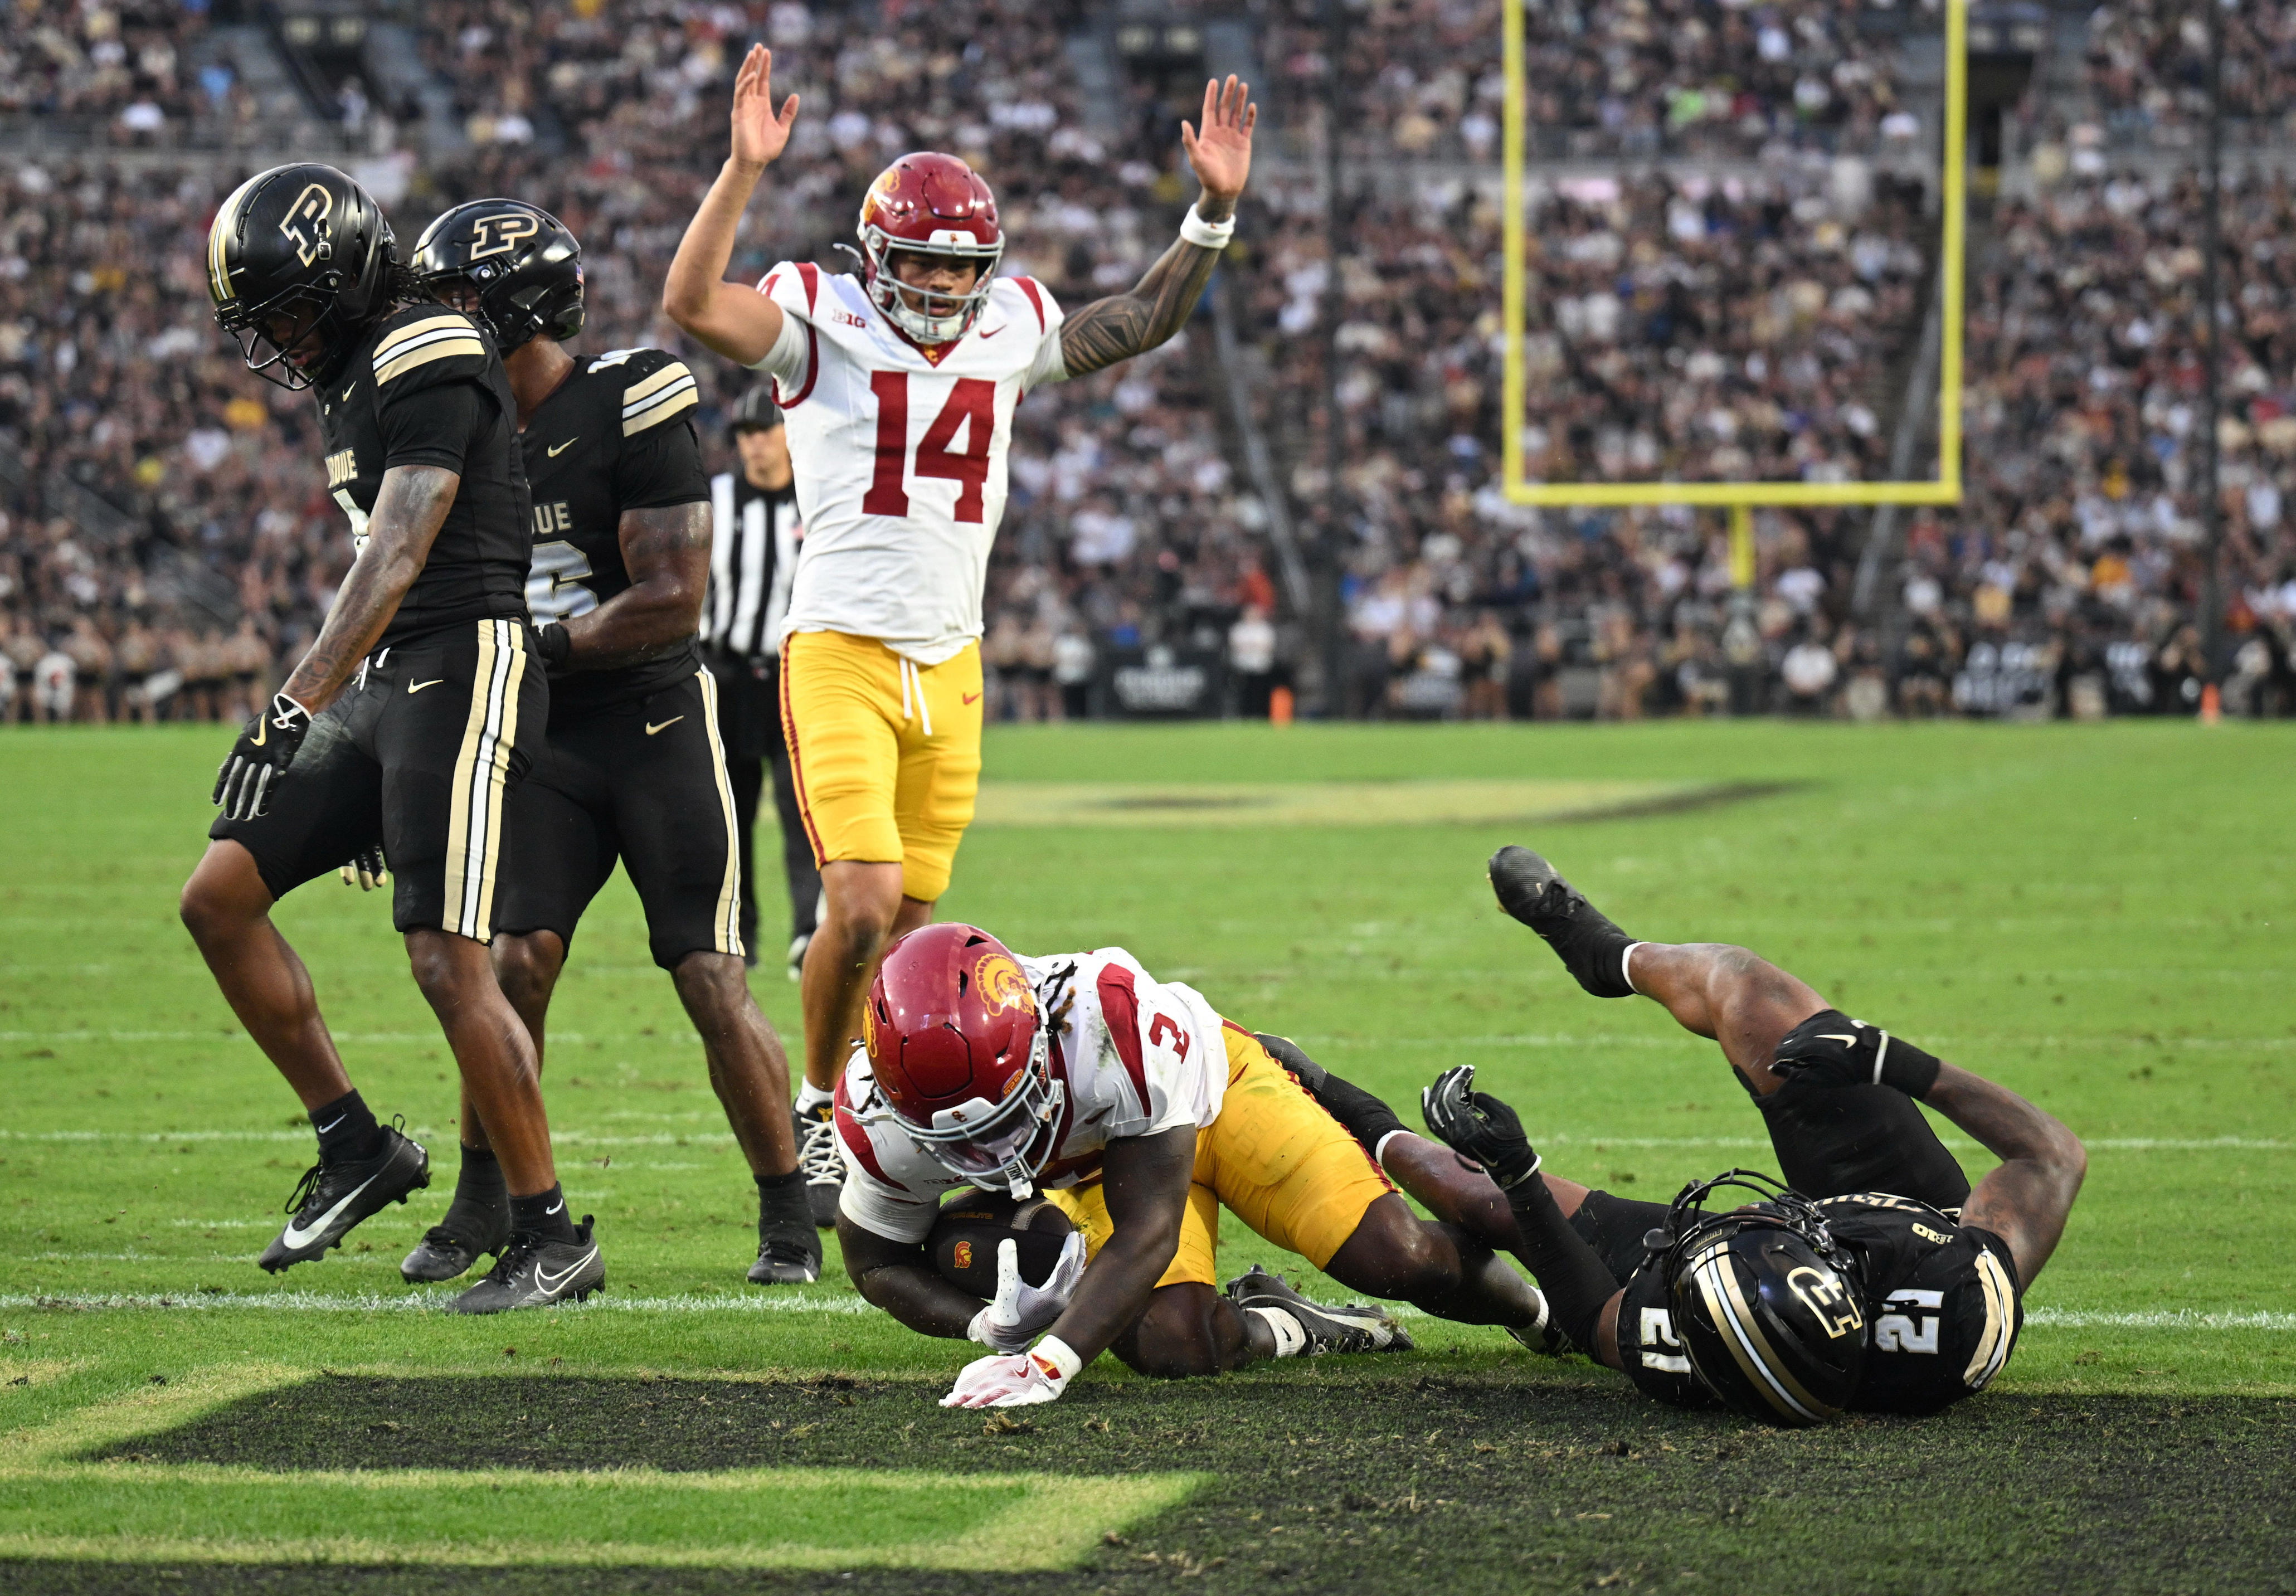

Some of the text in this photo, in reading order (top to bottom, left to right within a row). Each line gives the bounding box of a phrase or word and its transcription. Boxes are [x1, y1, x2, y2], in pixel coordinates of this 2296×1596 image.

[470, 213, 538, 260] P
[862, 370, 996, 524] 14
[532, 500, 574, 535] UE
[1149, 1012, 1190, 1065] 2
[1875, 1288, 1944, 1355] 21
